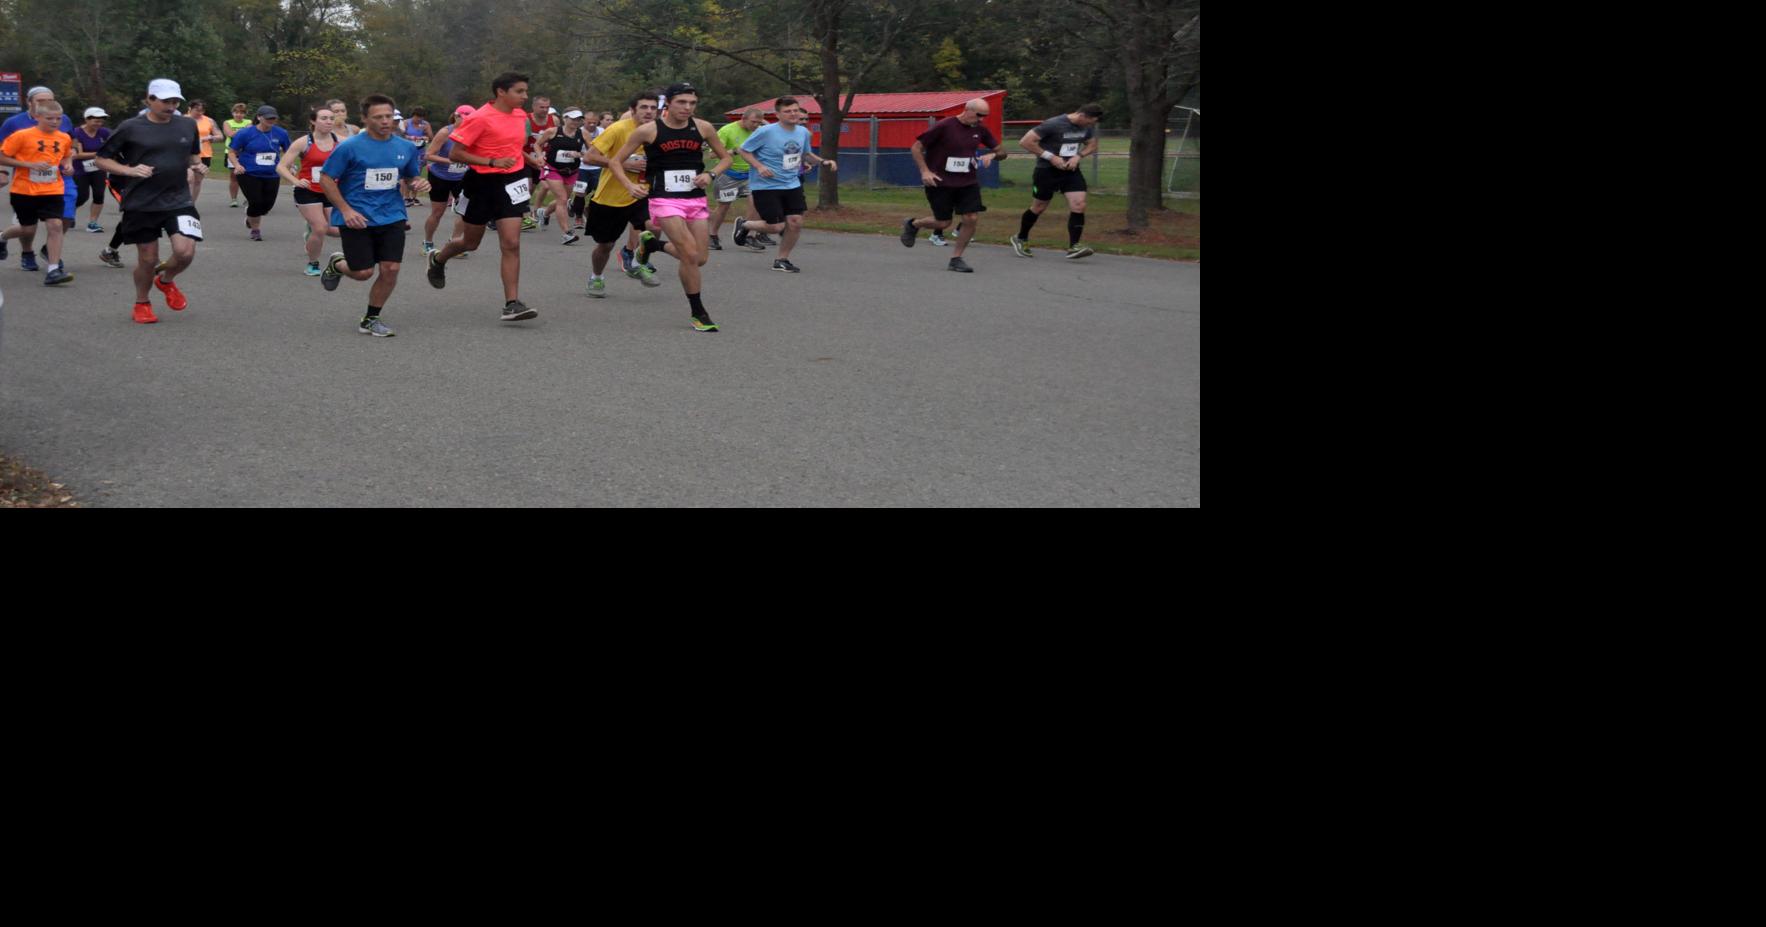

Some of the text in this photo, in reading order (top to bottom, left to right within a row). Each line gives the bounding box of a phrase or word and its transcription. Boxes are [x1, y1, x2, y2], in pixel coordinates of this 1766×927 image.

[660, 139, 700, 152] BOSTON
[375, 172, 393, 182] 150
[673, 174, 691, 183] 149
